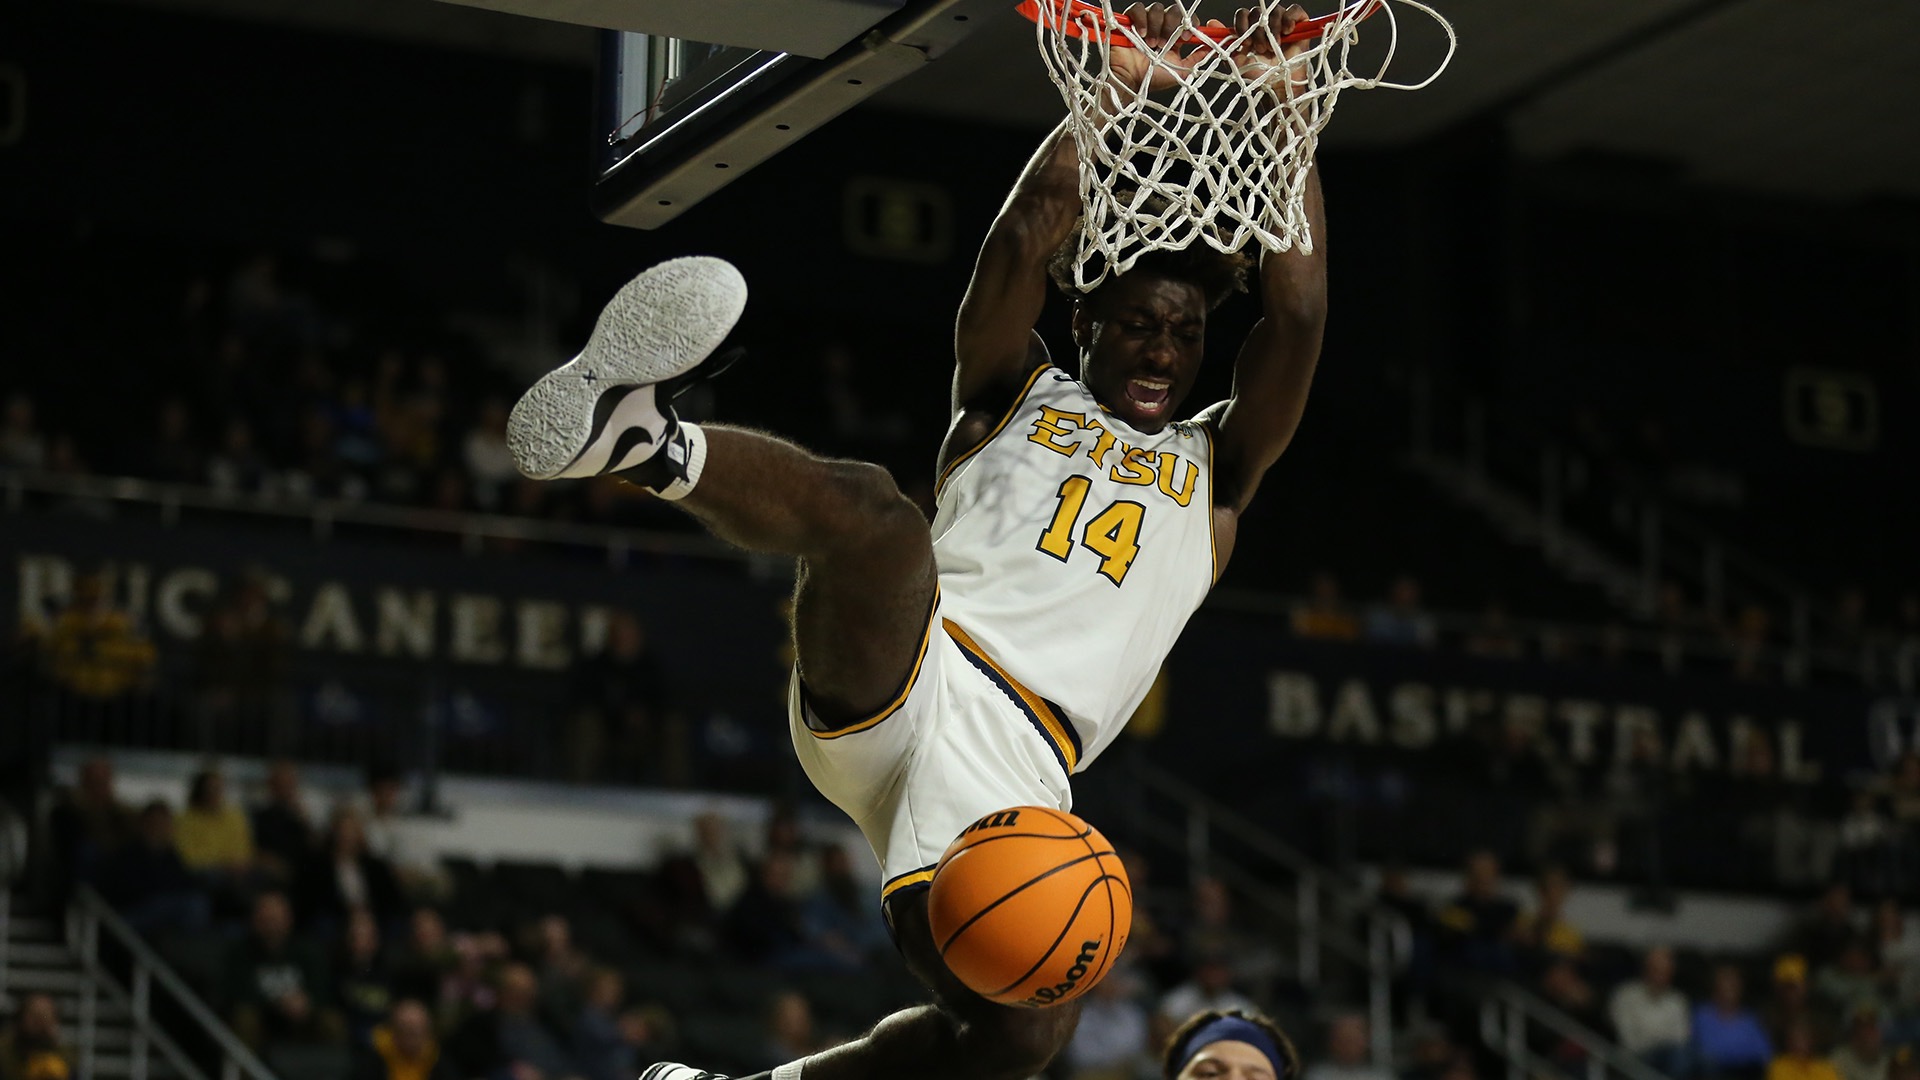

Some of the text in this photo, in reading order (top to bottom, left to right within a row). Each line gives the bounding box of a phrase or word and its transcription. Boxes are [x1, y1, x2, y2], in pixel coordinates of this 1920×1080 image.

[1027, 404, 1199, 508] ETSU
[1035, 474, 1147, 588] 14
[1019, 940, 1101, 1007] ilson
